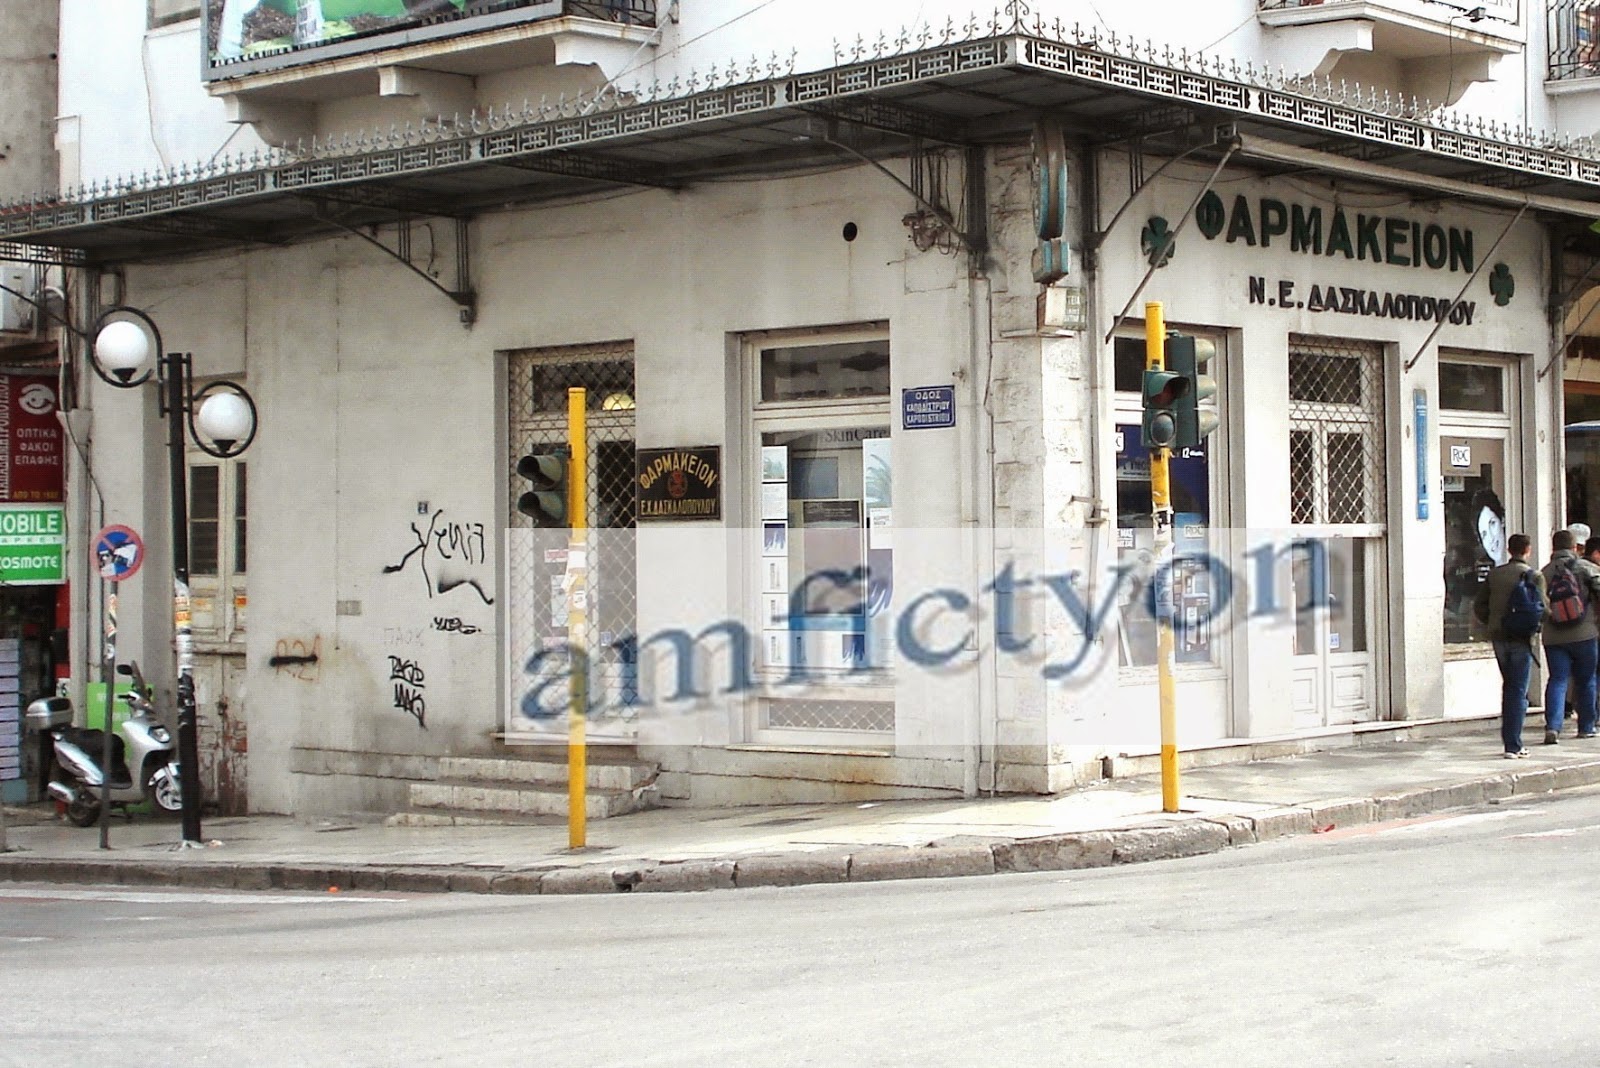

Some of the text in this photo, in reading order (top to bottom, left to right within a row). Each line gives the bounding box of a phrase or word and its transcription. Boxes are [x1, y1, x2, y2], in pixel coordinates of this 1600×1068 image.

[1195, 189, 1474, 274] ΦΑΡΜΑΚΕΙΟΝ
[915, 390, 941, 400] ΟΔΟΣ
[16, 428, 57, 439] ΟΠΤΙΚΑ
[20, 443, 53, 452] ΦΑΚΟΙ
[15, 455, 58, 465] ΕΠΑΦΗΣ
[640, 452, 717, 489] ΦΑΡΜΑΚΕΙΟΝ
[0, 514, 58, 533] OBILE
